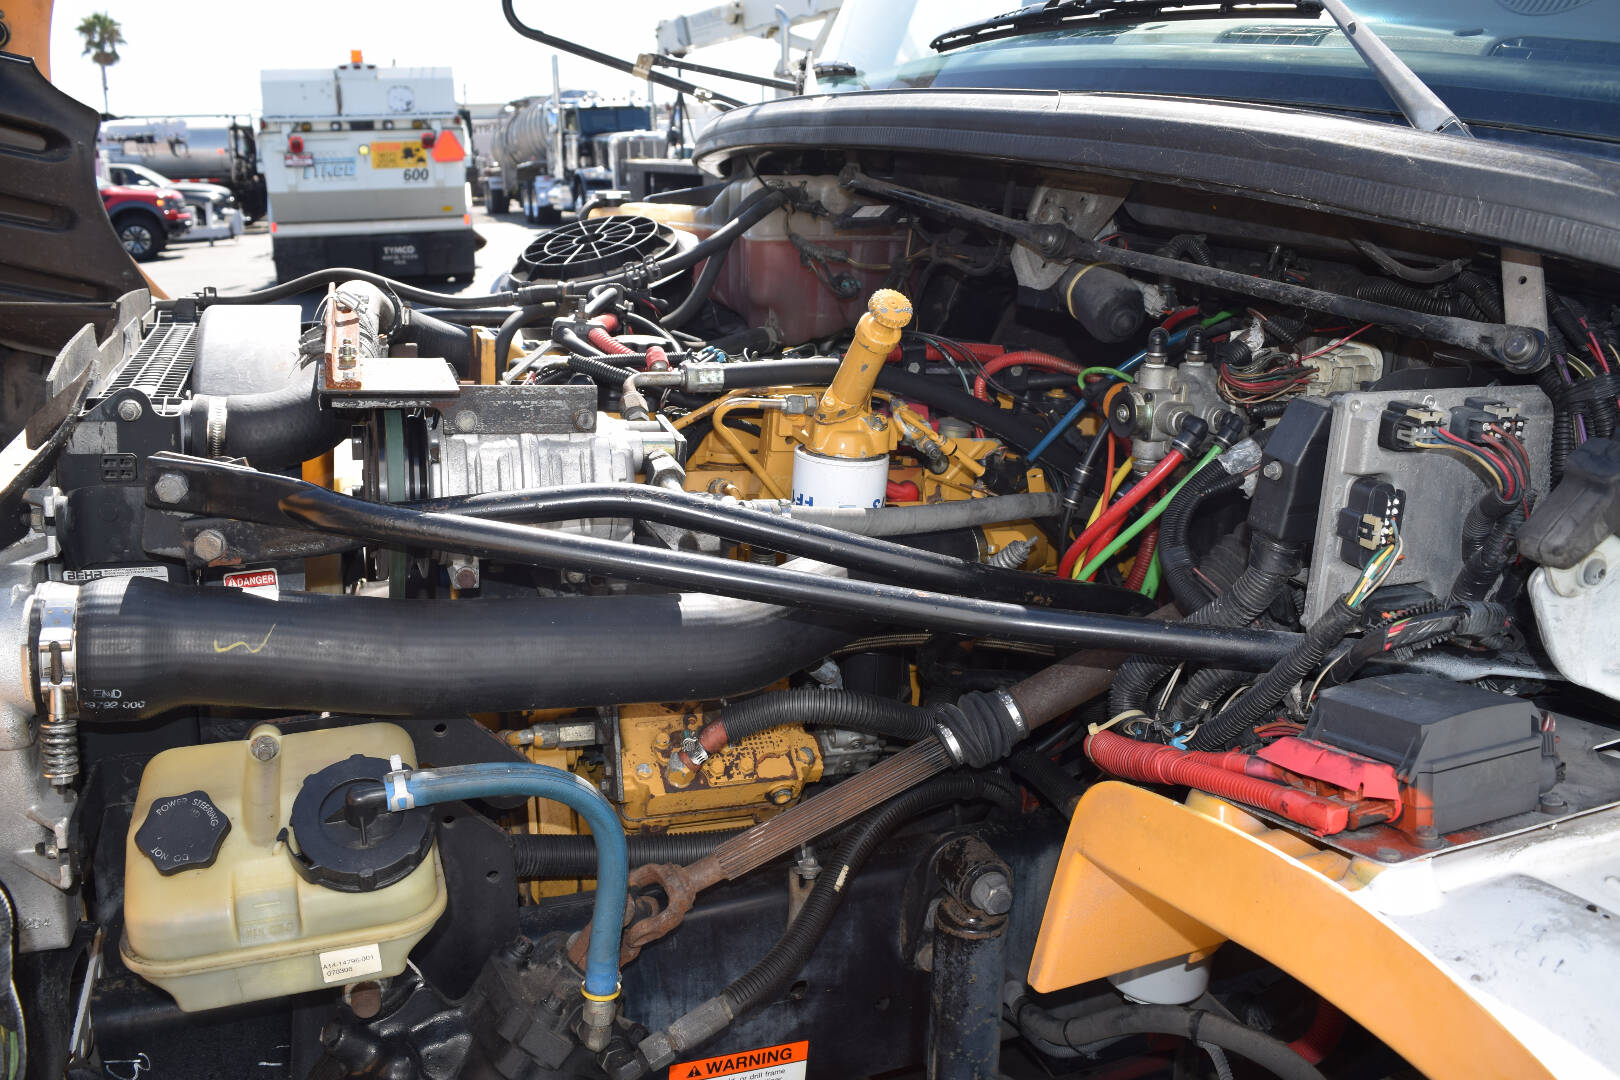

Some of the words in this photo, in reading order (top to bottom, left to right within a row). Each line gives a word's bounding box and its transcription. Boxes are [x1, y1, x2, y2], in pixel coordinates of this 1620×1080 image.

[403, 168, 429, 181] 600
[67, 570, 103, 580] BEHR
[237, 574, 275, 587] DANGER
[156, 798, 188, 816] POWER
[192, 798, 219, 827] STEERING
[706, 1048, 792, 1074] WARNING
[749, 1072, 763, 1080] drill
[765, 1068, 786, 1078] frame
